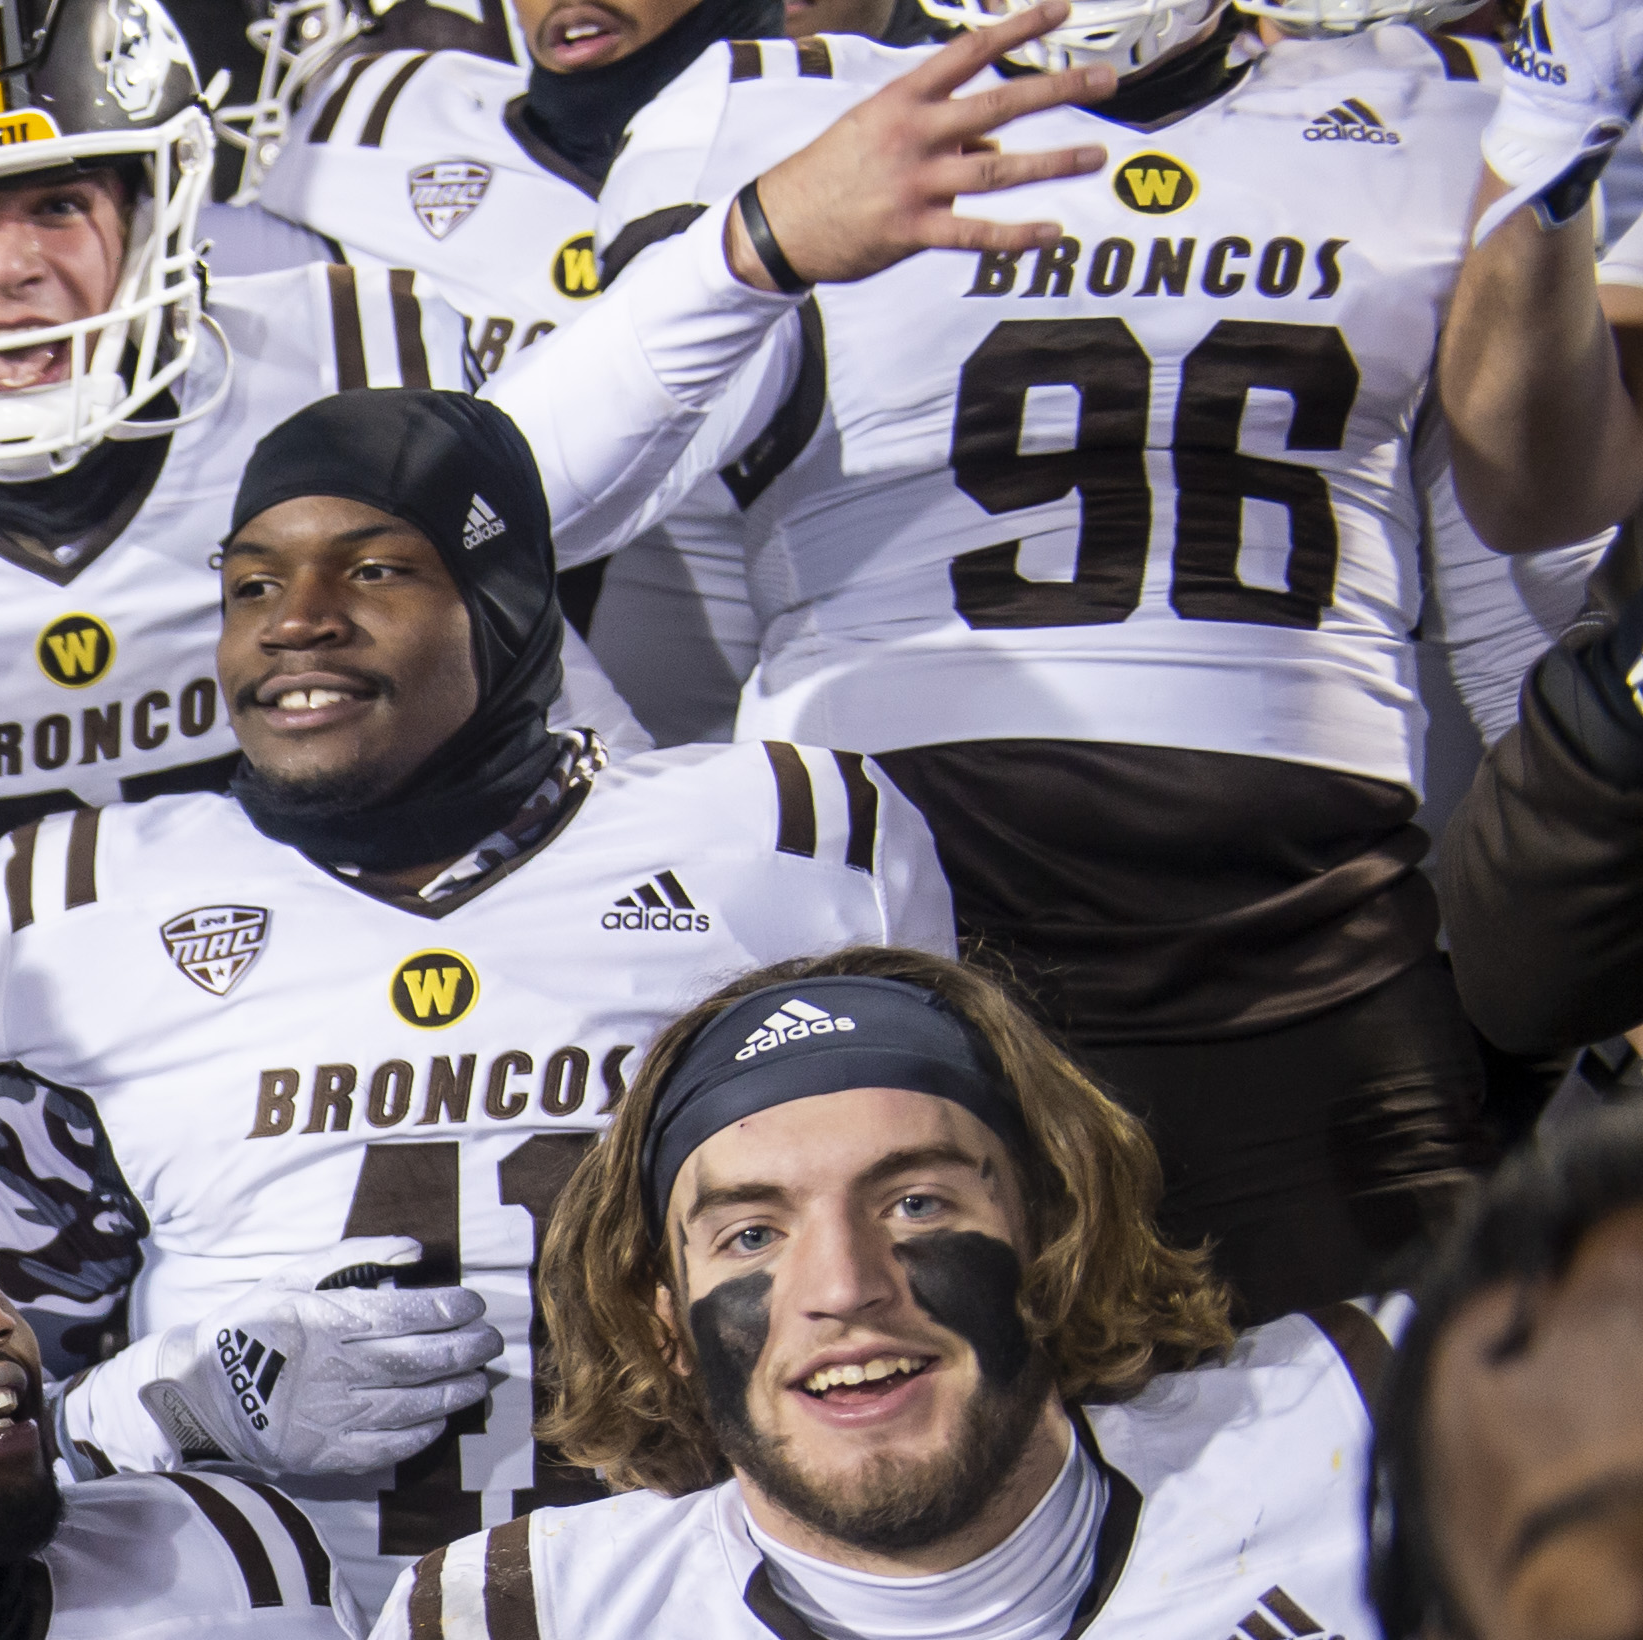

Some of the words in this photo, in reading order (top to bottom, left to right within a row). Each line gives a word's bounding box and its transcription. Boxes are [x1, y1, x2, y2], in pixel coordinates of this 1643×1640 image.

[1303, 123, 1401, 145] adidas
[1124, 169, 1182, 206] W
[962, 236, 1351, 299] BRONCOS
[949, 316, 1361, 630] 96
[463, 518, 506, 550] adidas
[46, 628, 99, 677] W
[601, 904, 710, 932] adidas
[172, 925, 262, 963] MAC
[400, 967, 471, 1016] W
[734, 1014, 856, 1064] adidas
[245, 1043, 635, 1140] BRONCOS
[217, 1328, 269, 1431] adidas
